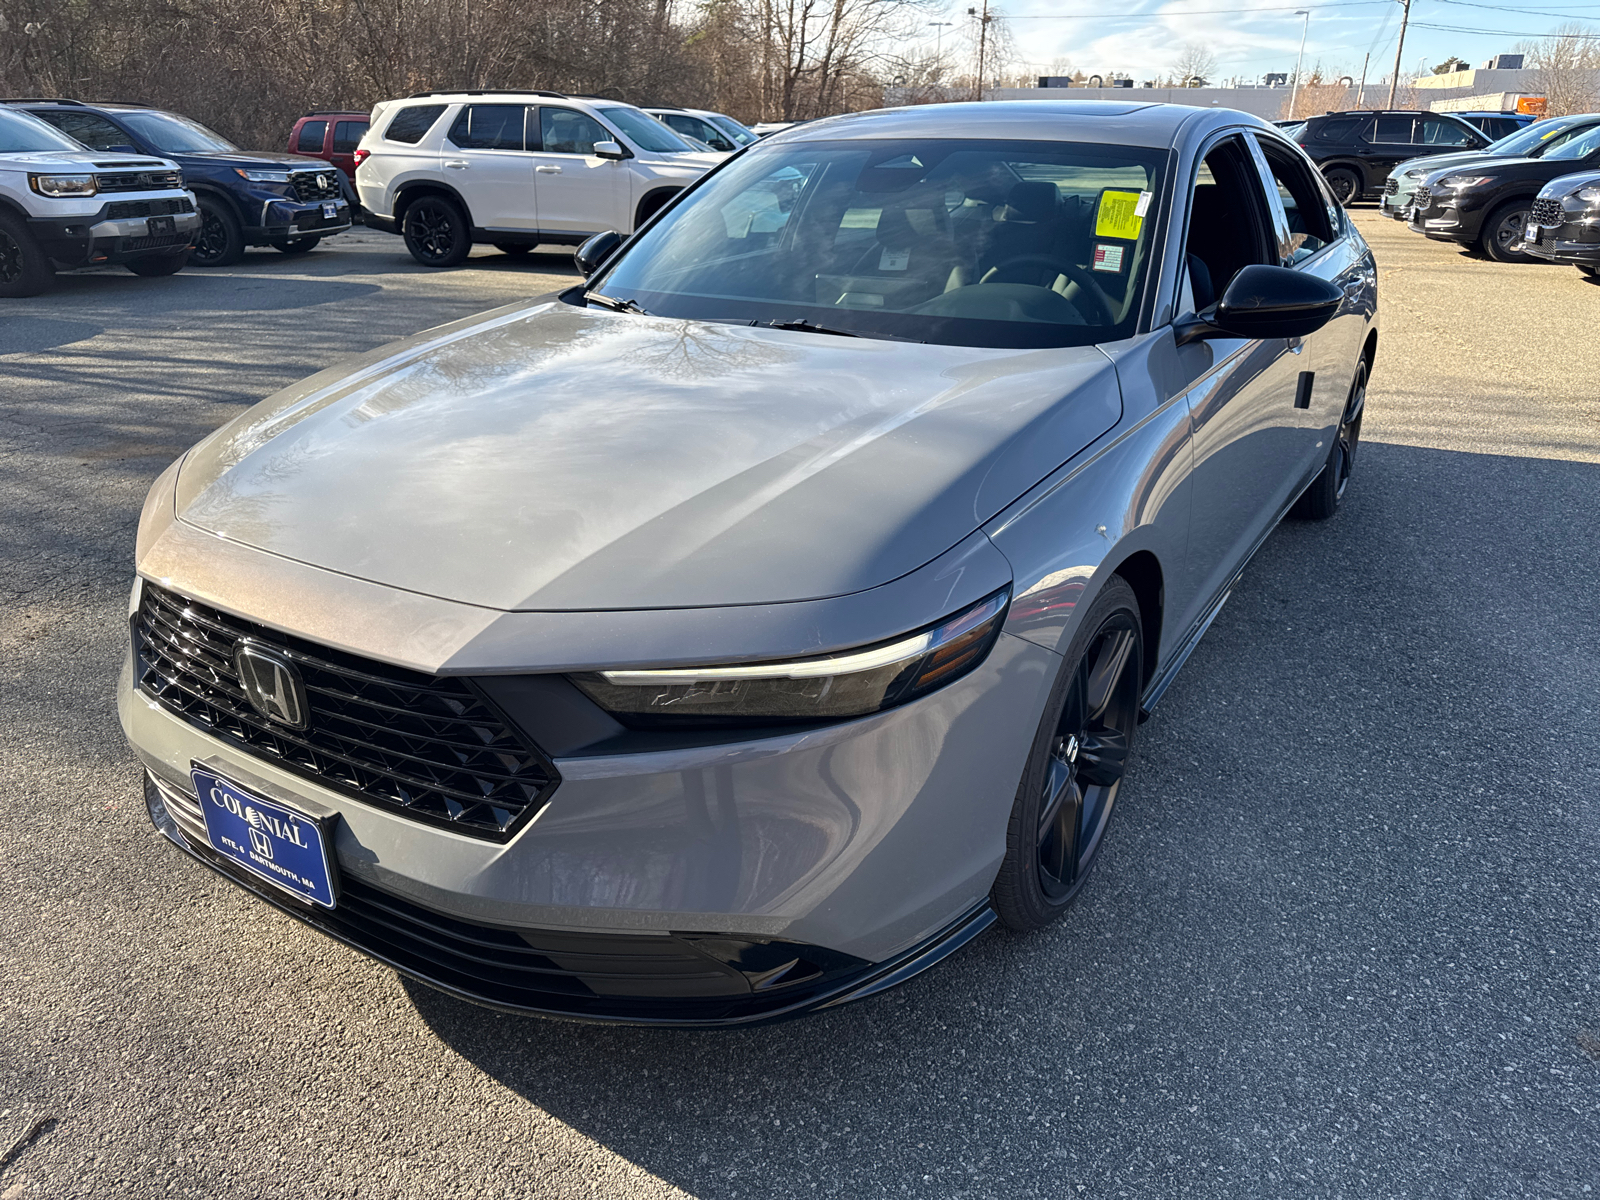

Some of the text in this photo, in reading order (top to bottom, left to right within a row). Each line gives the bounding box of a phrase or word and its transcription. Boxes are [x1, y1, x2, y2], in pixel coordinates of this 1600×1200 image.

[239, 846, 245, 854] 6
[249, 850, 301, 884] DARTMOUTH,
[301, 876, 316, 890] MA
